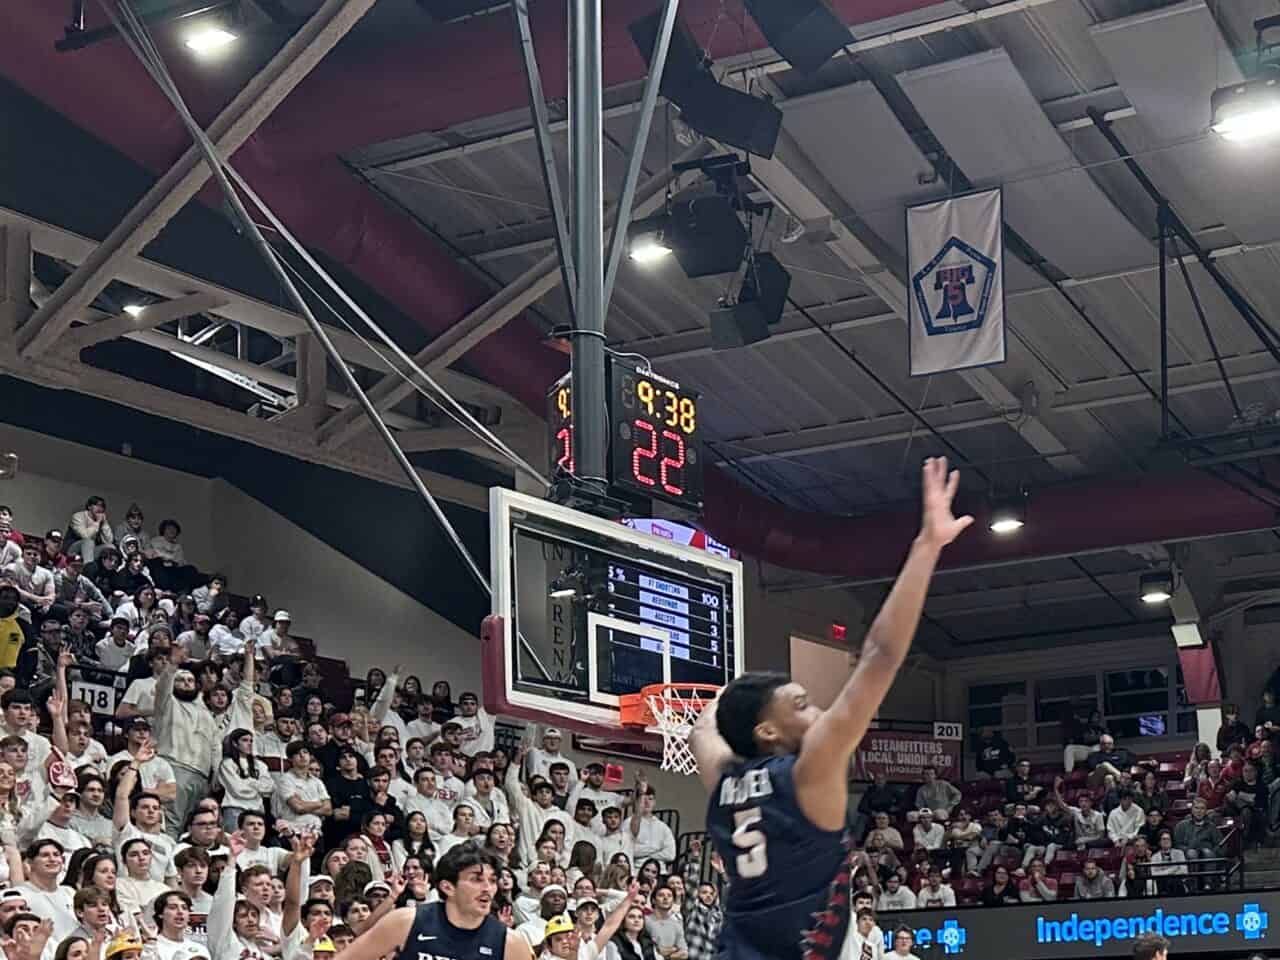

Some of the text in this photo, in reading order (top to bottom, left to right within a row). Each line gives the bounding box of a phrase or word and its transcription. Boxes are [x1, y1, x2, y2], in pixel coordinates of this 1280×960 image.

[638, 380, 695, 434] 9:38
[633, 419, 686, 495] 22
[702, 593, 718, 607] 100
[79, 688, 108, 709] 118
[937, 726, 959, 737] 201
[871, 738, 943, 754] STEAMFITTERS
[863, 750, 894, 765] LOCAL
[897, 752, 929, 767] UNION
[731, 806, 768, 878] 5
[1037, 908, 1230, 946] Independence
